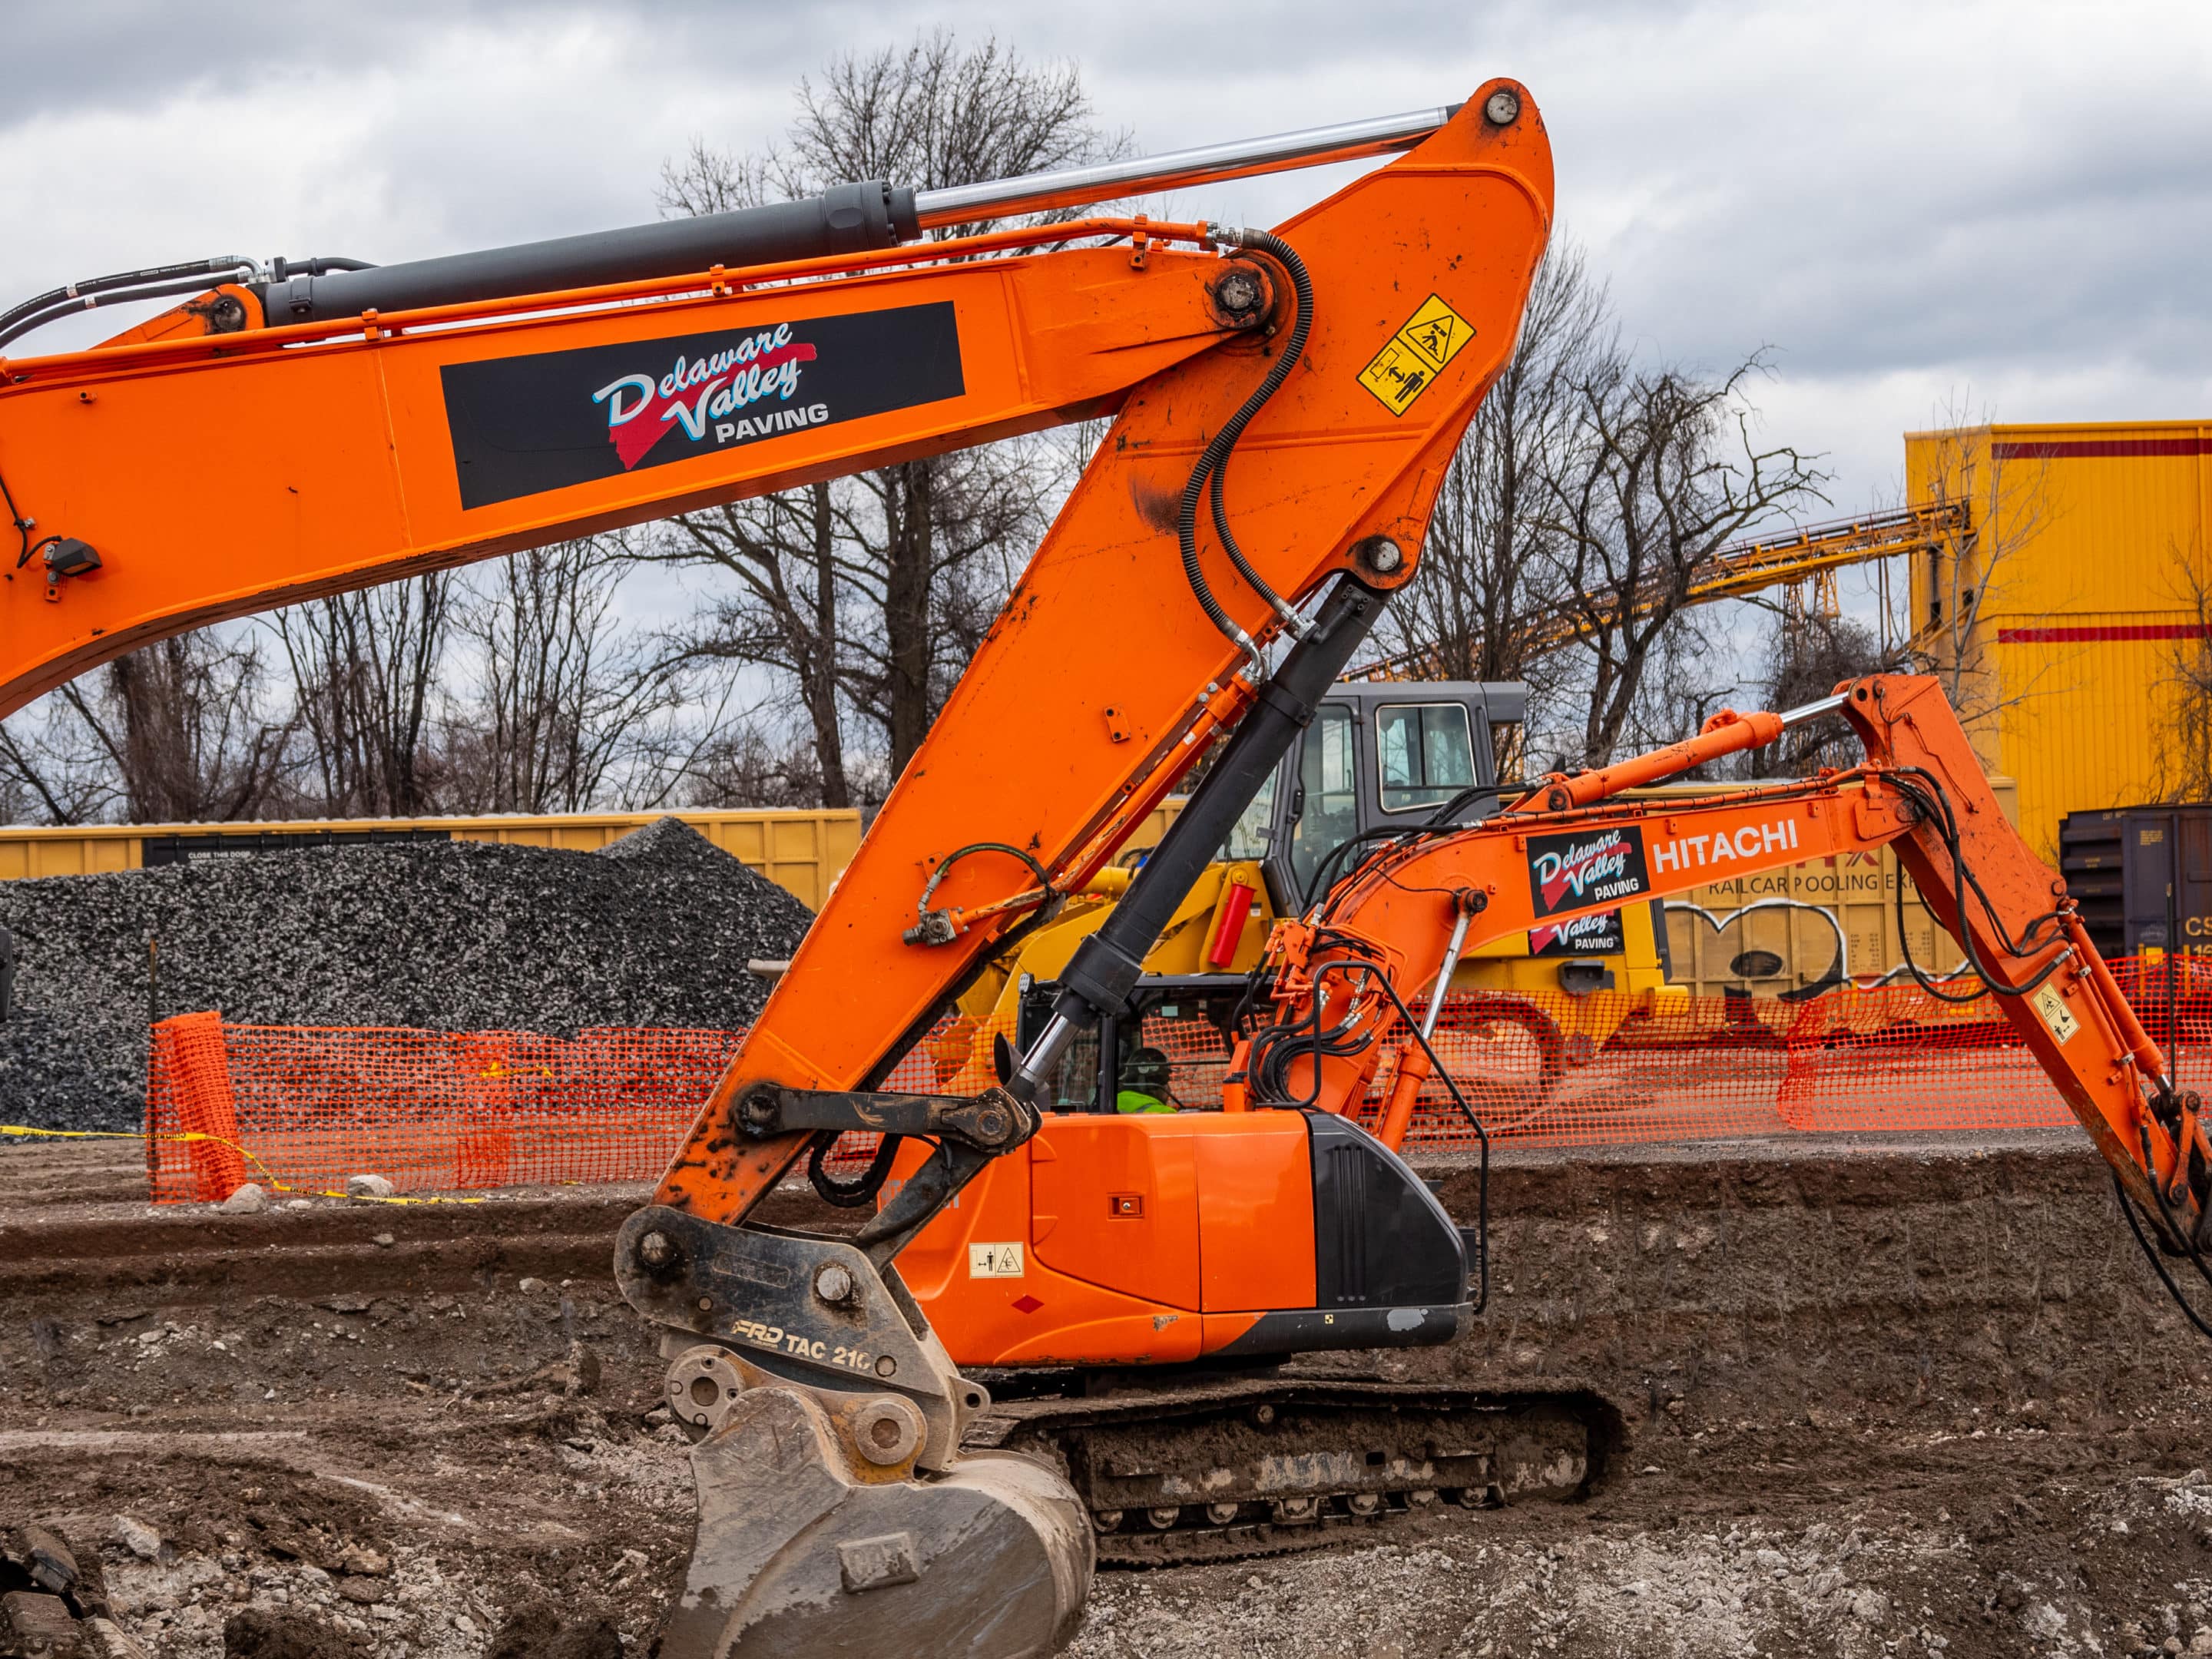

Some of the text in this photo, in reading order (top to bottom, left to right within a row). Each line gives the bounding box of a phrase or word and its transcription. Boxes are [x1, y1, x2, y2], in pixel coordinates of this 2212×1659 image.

[591, 323, 793, 427] Delaware
[660, 357, 802, 441] Valley
[715, 403, 830, 443] PAVING
[1533, 830, 1621, 886] Delaware
[1653, 819, 1799, 873] HITACHI
[1562, 852, 1626, 897] Valley
[1594, 877, 1640, 901] PAVING
[1709, 877, 1789, 895] RAILCAR
[1793, 873, 1878, 892] POOLING
[1550, 914, 1608, 946] Valley
[1575, 937, 1614, 950] PAVING
[786, 1334, 827, 1359] TAC
